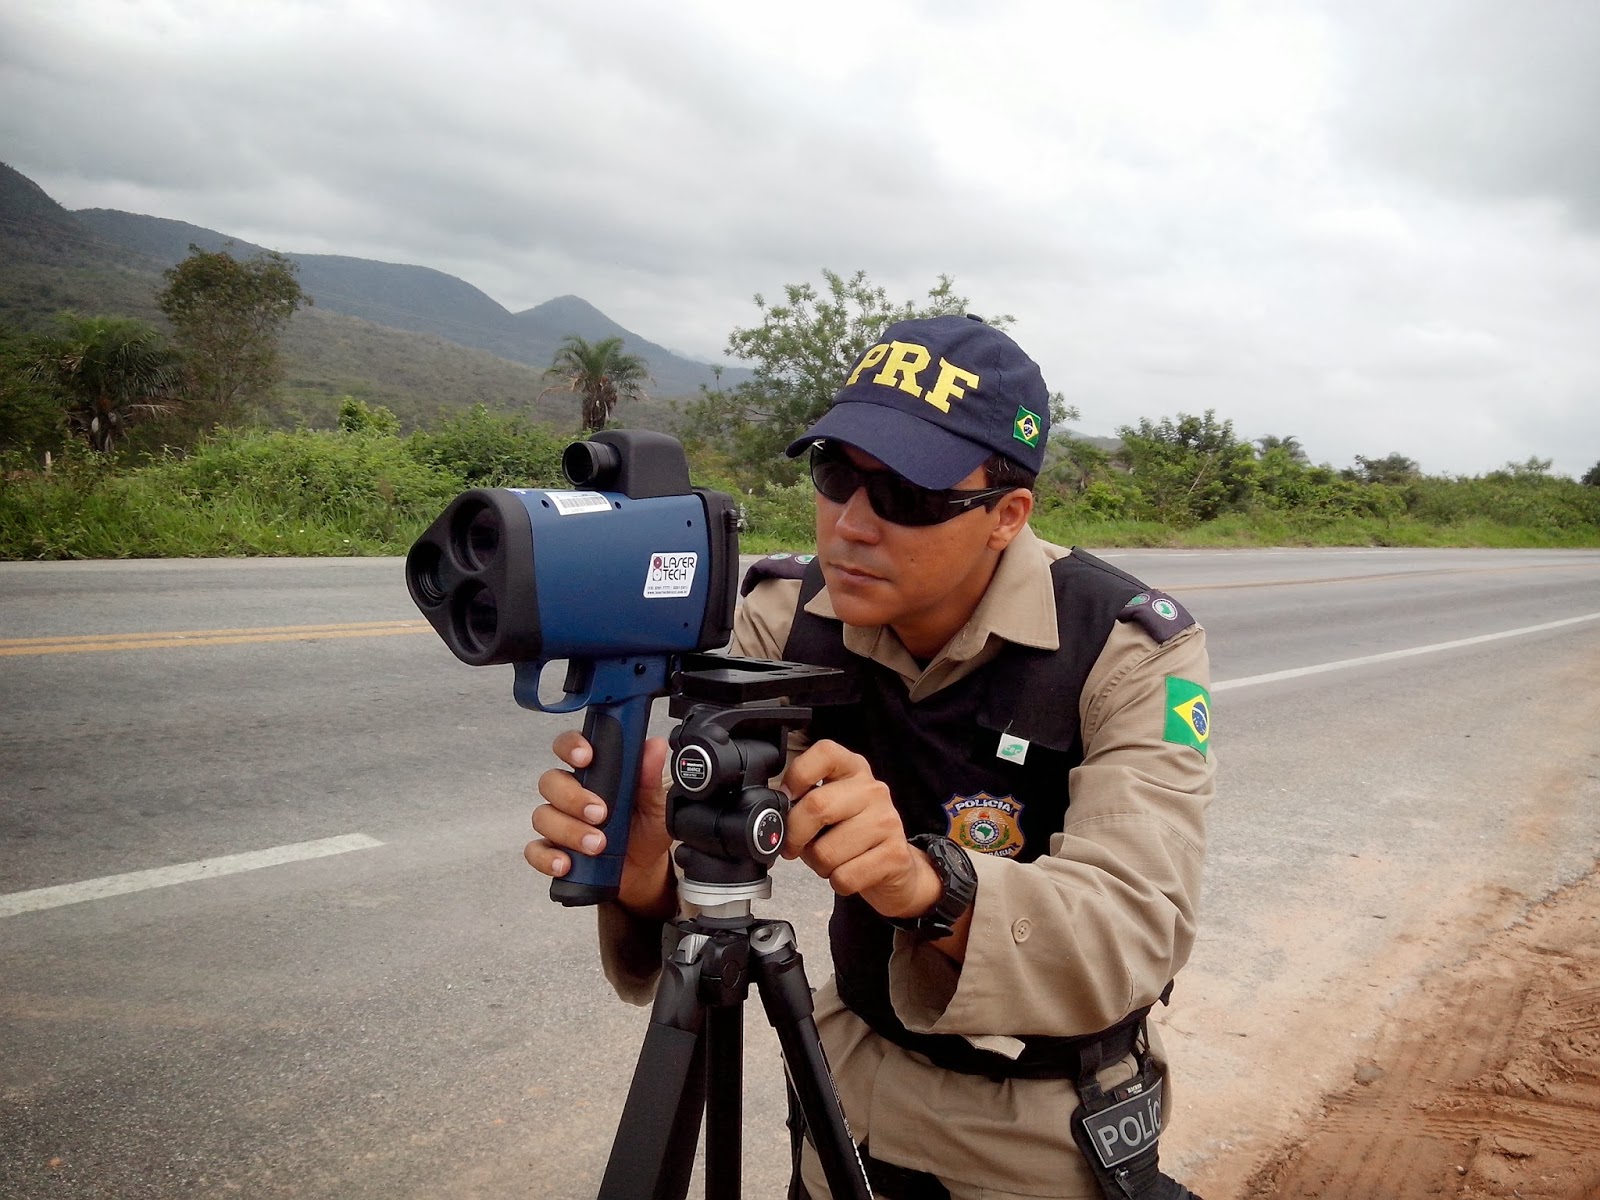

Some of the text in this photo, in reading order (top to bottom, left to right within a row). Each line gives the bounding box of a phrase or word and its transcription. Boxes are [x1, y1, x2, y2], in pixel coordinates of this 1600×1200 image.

[845, 340, 980, 414] PRF
[662, 569, 687, 581] TECH
[663, 556, 695, 569] LASER
[1097, 1097, 1161, 1157] POLÍC
